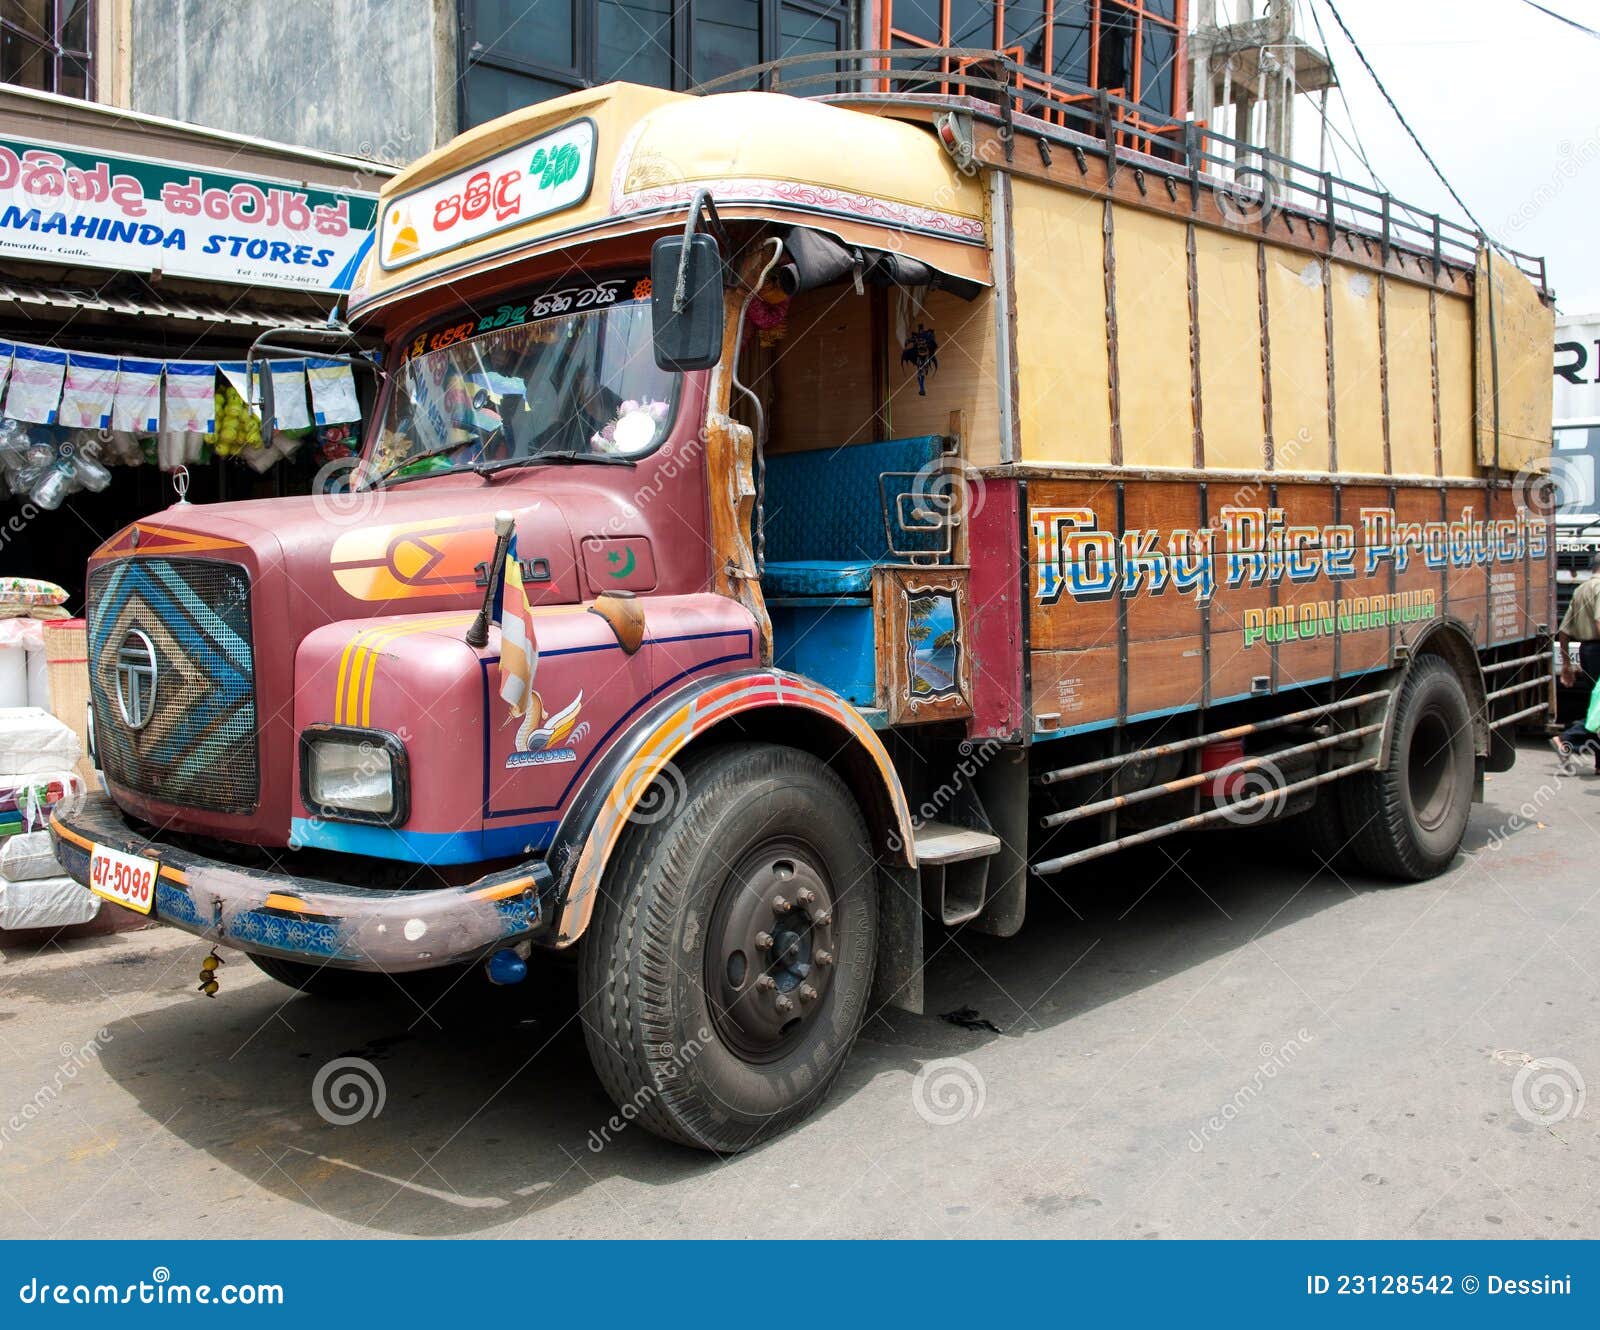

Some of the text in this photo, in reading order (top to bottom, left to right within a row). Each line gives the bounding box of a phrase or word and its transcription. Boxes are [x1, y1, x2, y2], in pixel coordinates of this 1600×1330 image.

[1, 205, 335, 268] MAHINDA STORES
[474, 557, 551, 588] 110
[1220, 506, 1358, 592] Rice
[1359, 505, 1548, 580] Products
[93, 855, 151, 902] 47-5098
